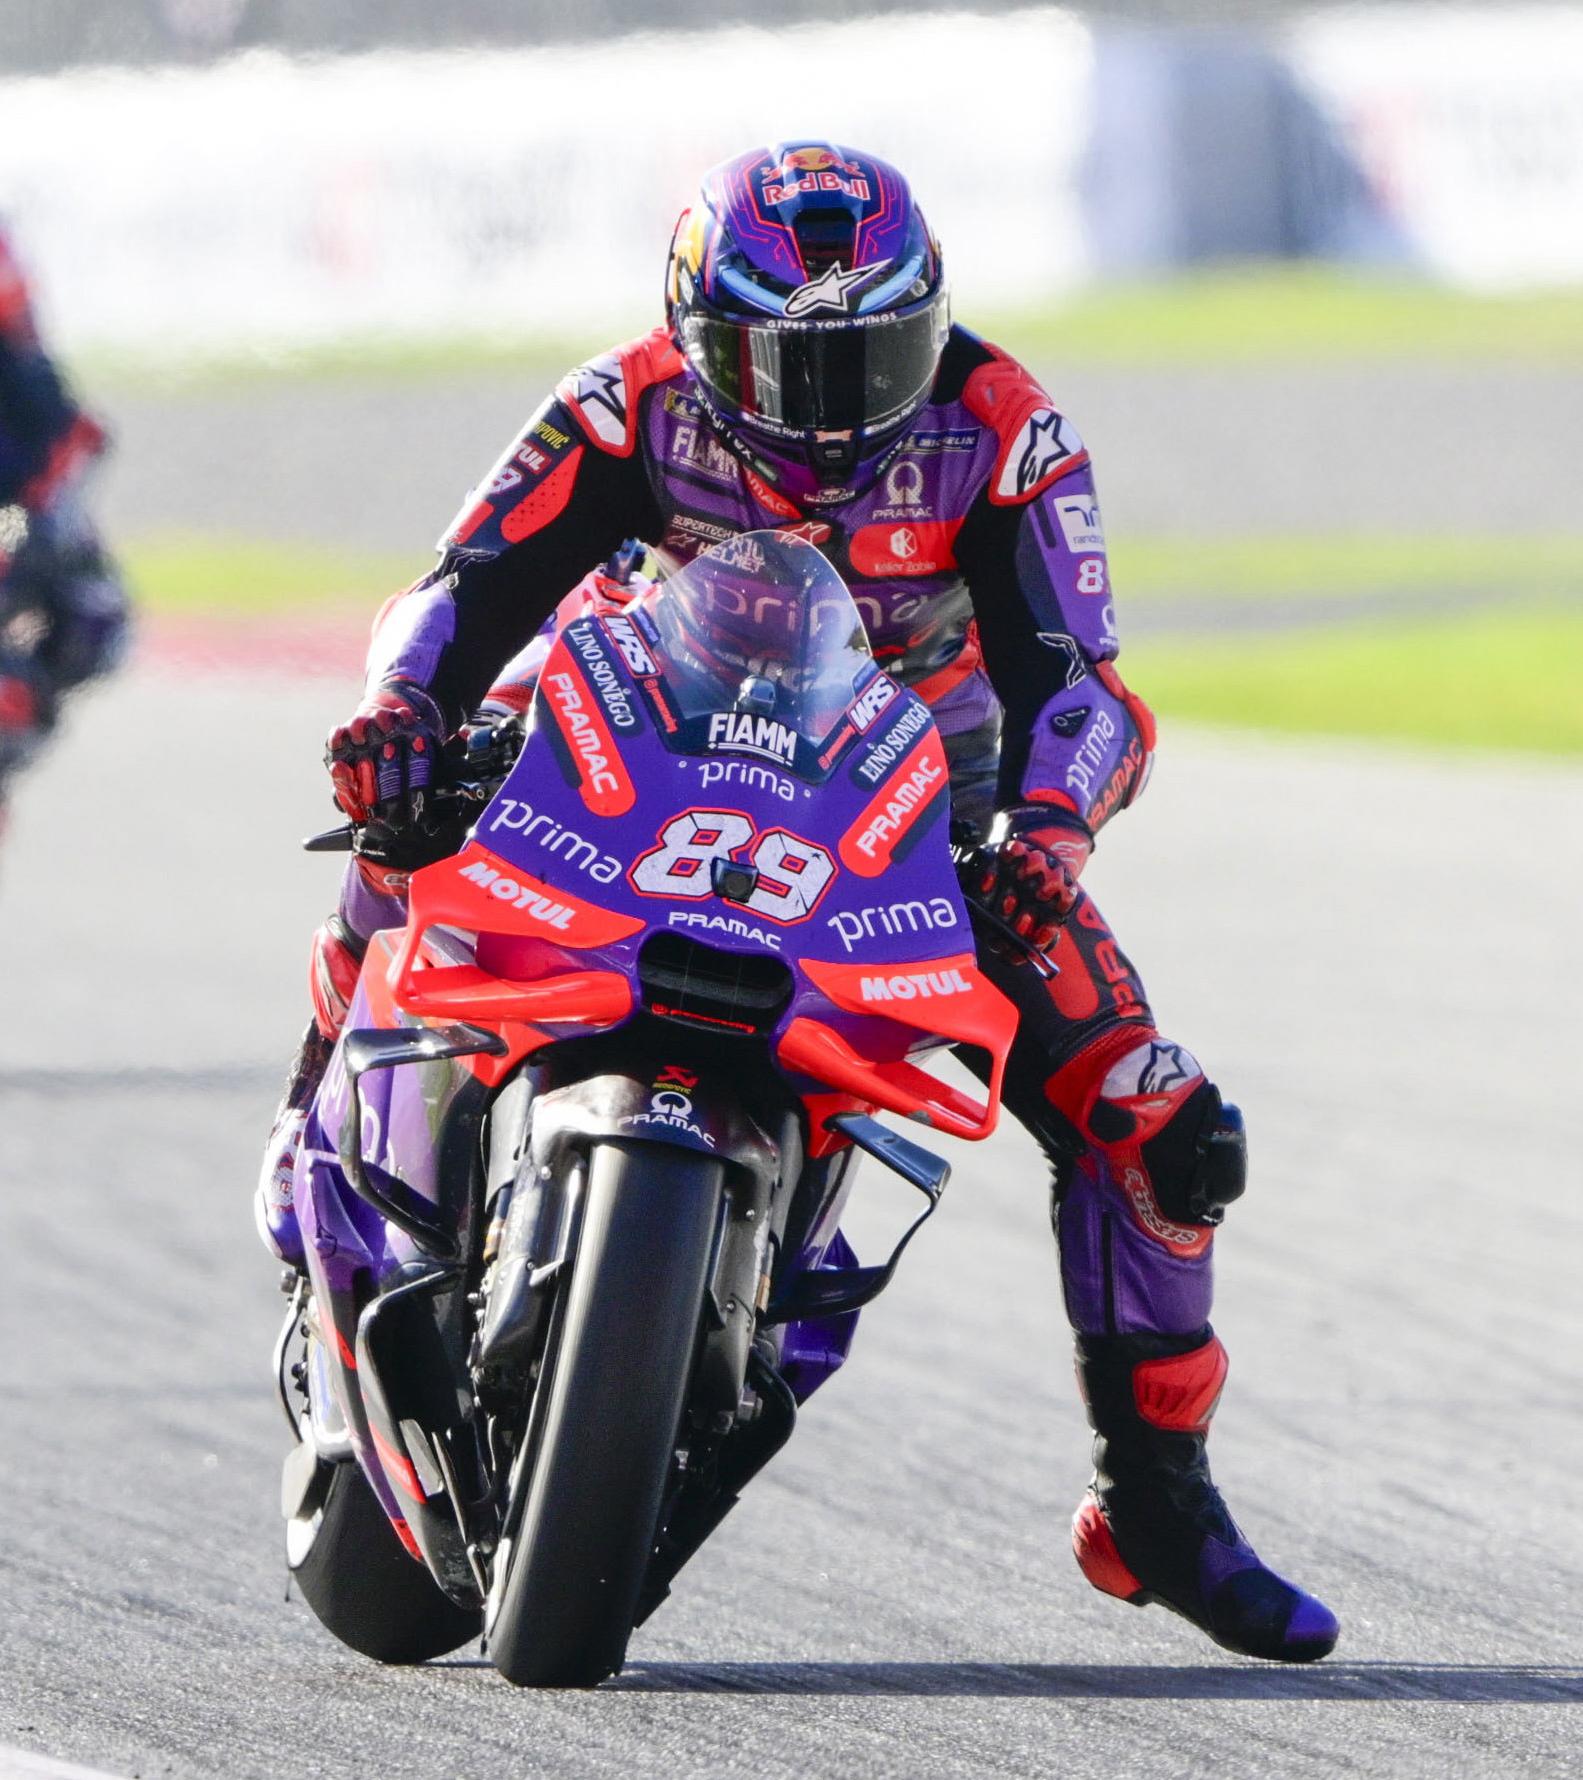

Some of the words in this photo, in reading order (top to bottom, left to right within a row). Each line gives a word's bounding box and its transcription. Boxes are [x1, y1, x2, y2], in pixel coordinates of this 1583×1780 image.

[762, 173, 816, 205] Red
[818, 172, 871, 201] Bull
[816, 320, 846, 330] YOU
[852, 312, 898, 327] WINGS
[782, 426, 806, 439] Right
[672, 514, 732, 539] SUPERTECH
[871, 506, 933, 520] PRAMAC
[697, 541, 767, 573] HELMET
[1076, 557, 1112, 595] 8
[701, 579, 928, 640] prima
[603, 616, 658, 675] WRS
[568, 621, 604, 661] LINO
[587, 661, 635, 727] SONEGO
[849, 675, 896, 731] WRS
[547, 672, 619, 795] PRAMAC
[707, 711, 798, 762] FIAMM
[858, 742, 897, 783] LINO
[885, 697, 931, 753] SONEGO
[1065, 709, 1116, 801] prima
[698, 761, 796, 801] prima
[855, 756, 942, 858] PRAMAC
[489, 798, 623, 884] prima
[626, 806, 840, 927] 89
[457, 861, 578, 931] MOTUL
[668, 911, 782, 951] PRAMAC
[826, 897, 959, 952] prima
[859, 969, 973, 1001] MOTUL
[617, 1112, 716, 1149] PRAMAC
